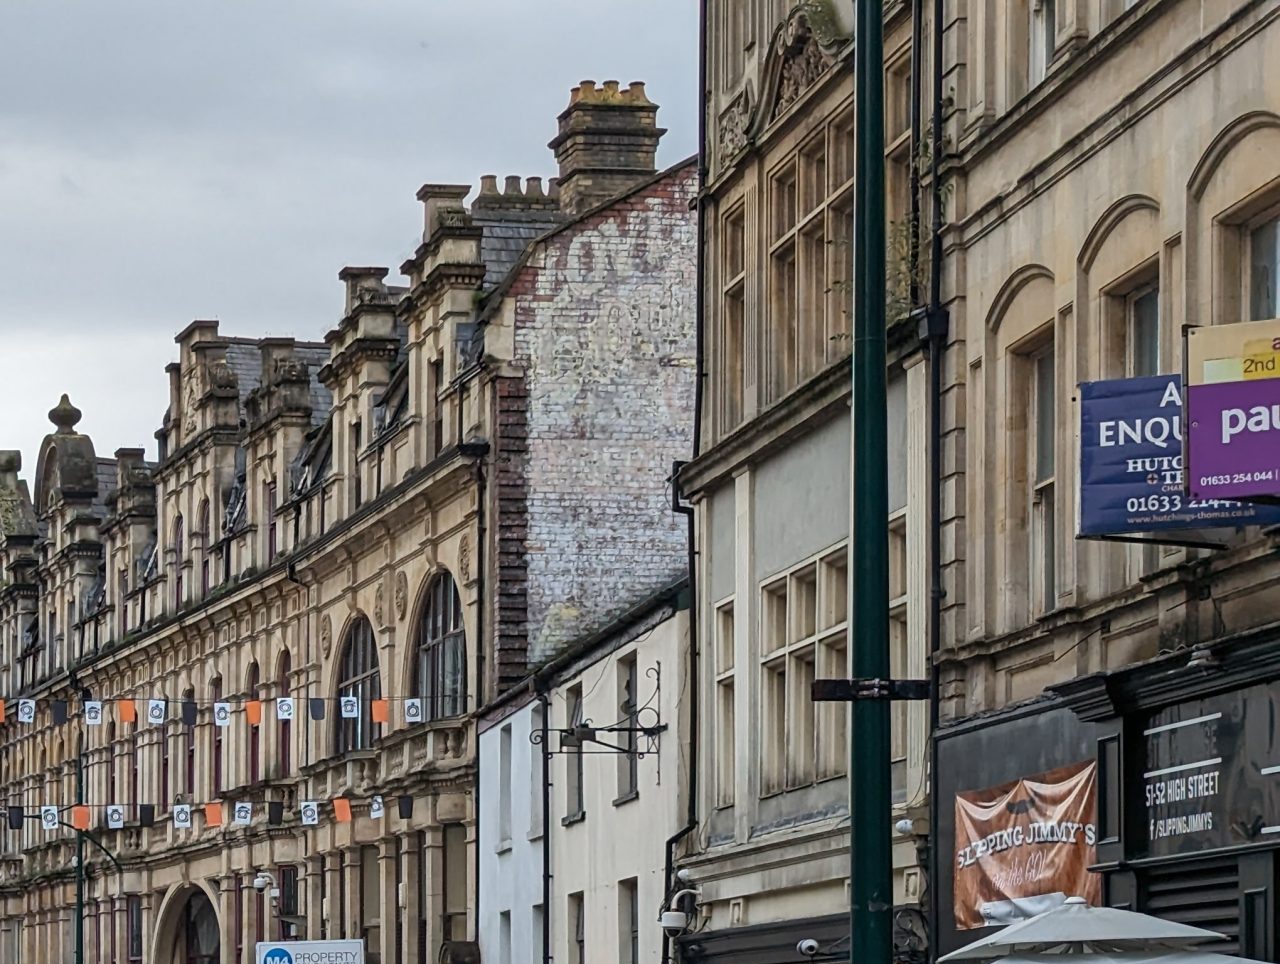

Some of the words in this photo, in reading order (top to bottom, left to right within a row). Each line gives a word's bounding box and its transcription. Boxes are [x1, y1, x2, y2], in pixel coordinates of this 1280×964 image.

[1243, 357, 1276, 374] 2nd
[1200, 475, 1231, 486] 01633
[1232, 474, 1252, 484] 254
[1254, 472, 1272, 482] 044
[1126, 495, 1181, 512] 01633
[1145, 782, 1166, 808] 51-52
[1167, 777, 1186, 803] HIGH
[1188, 771, 1220, 800] STREET
[957, 823, 1024, 870] SLIPPING
[1024, 822, 1097, 848] JIMMY'S
[295, 951, 358, 963] PROPERTY
